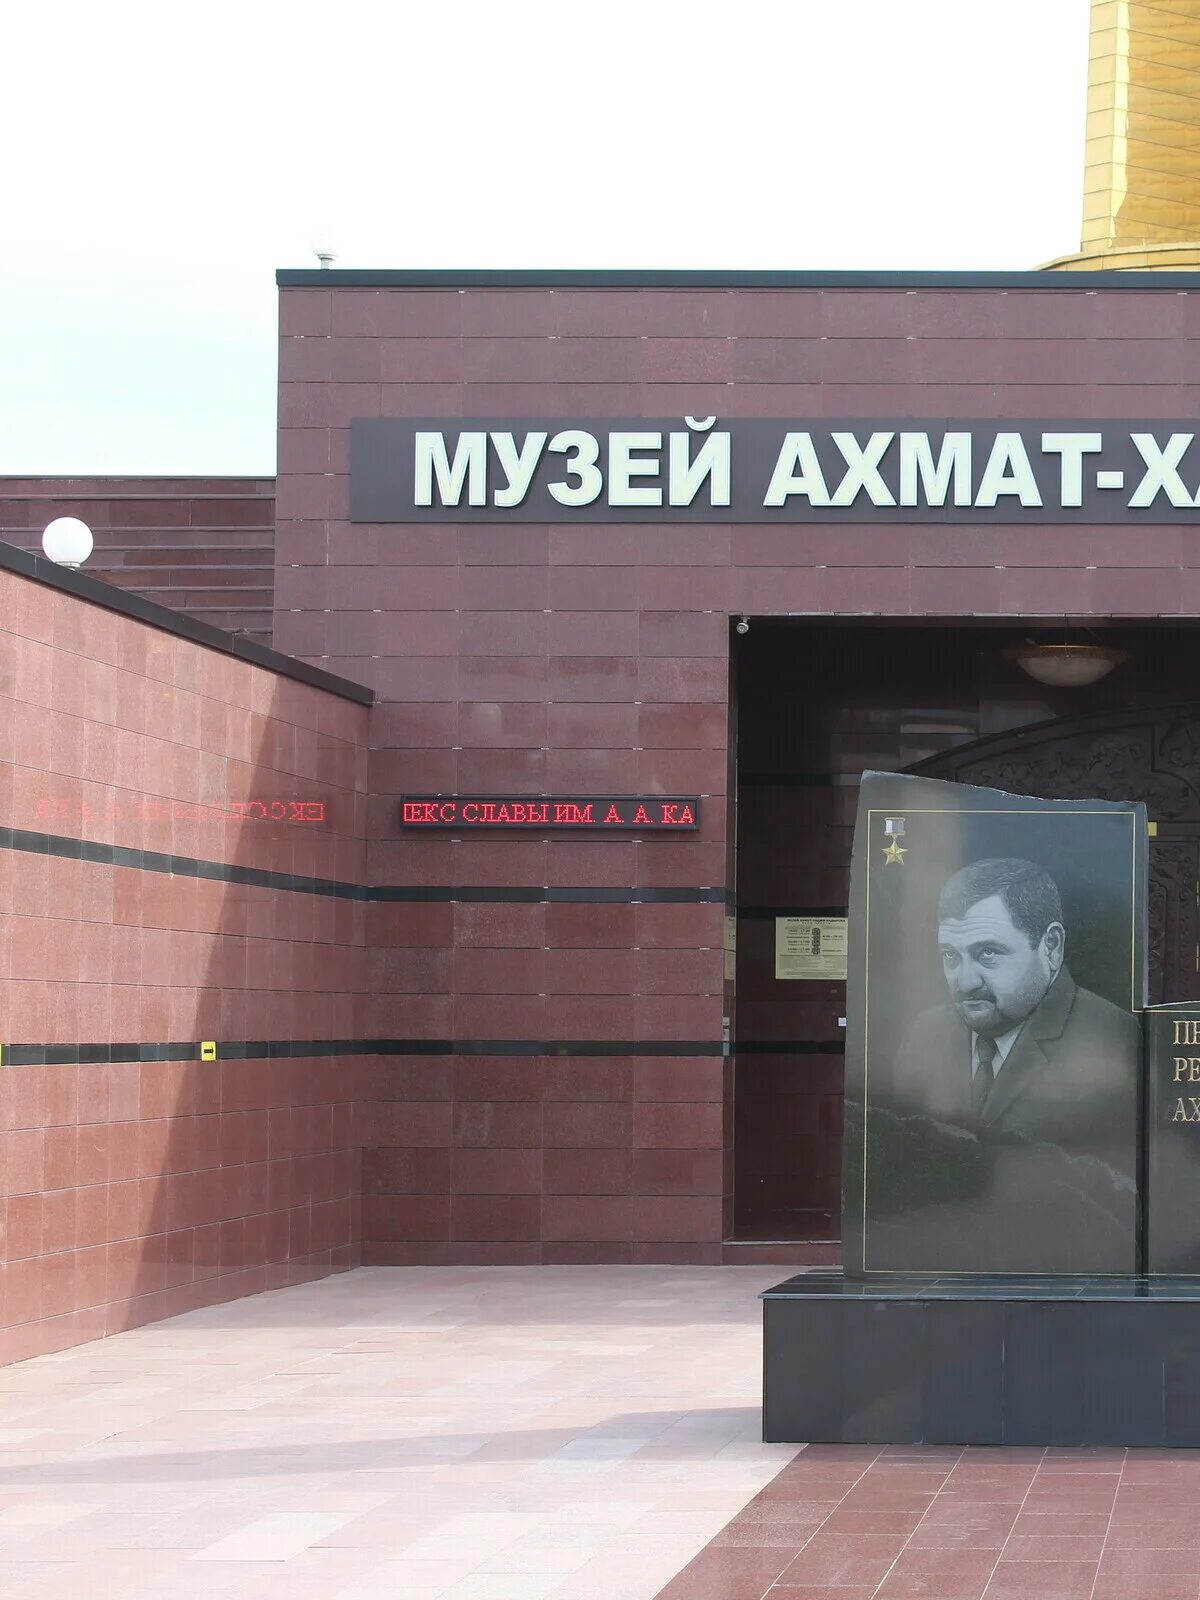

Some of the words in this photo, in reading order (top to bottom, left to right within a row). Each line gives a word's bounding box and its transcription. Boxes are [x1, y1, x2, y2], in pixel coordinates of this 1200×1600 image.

[413, 415, 731, 508] МУЗЕЙ
[462, 803, 550, 823] СЛАВЫ
[553, 804, 596, 823] ИМ.
[603, 804, 625, 824] А.
[632, 804, 654, 824] А.
[660, 804, 694, 824] КА
